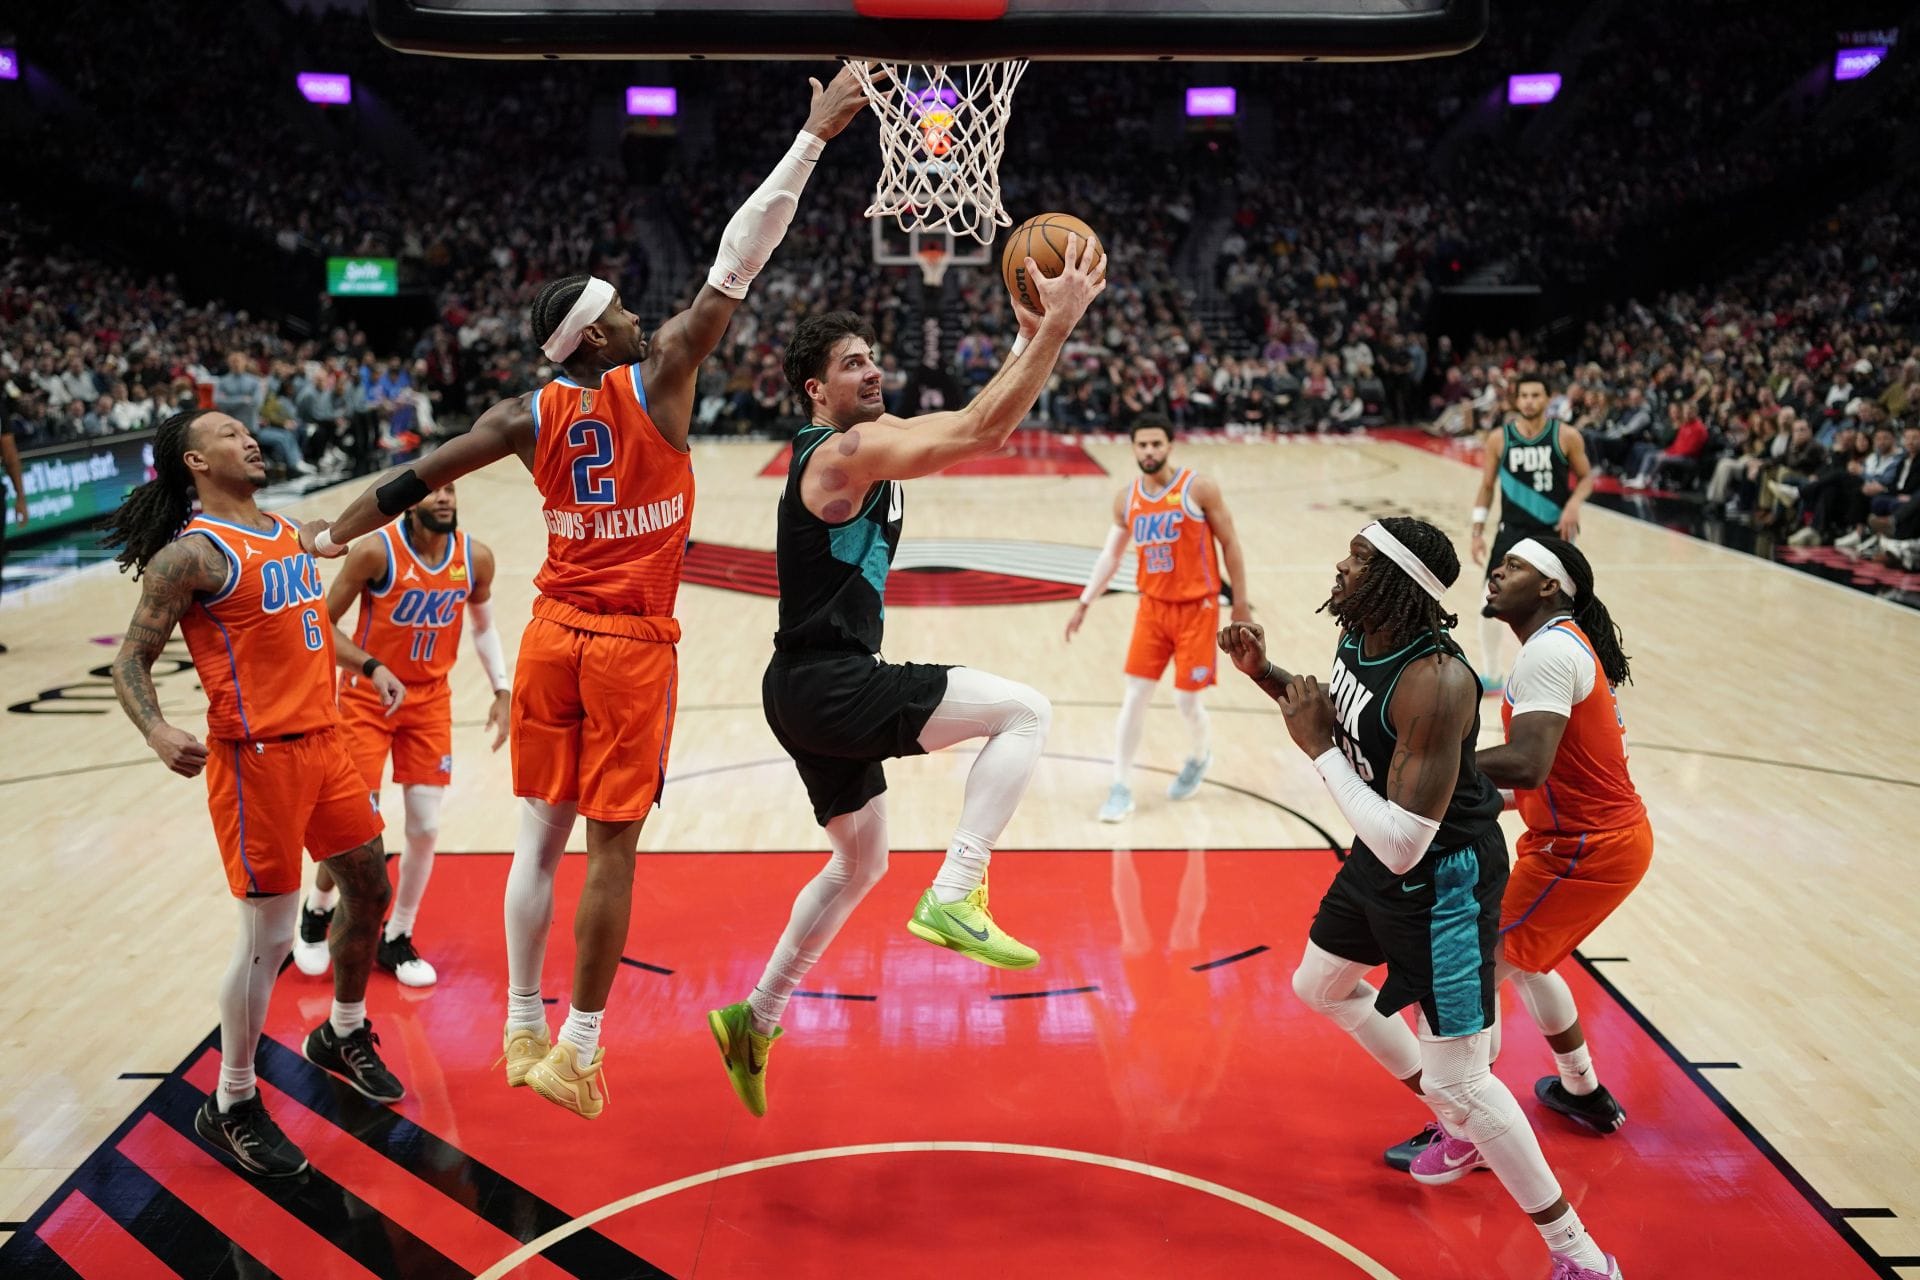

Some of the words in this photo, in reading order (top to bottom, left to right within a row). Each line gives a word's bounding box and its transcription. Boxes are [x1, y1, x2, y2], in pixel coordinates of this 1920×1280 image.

[567, 419, 616, 505] 2
[1508, 445, 1553, 473] PDX
[1133, 509, 1184, 546] OKC
[261, 552, 324, 614] OKC
[390, 588, 467, 627] OKC
[302, 608, 324, 651] 6
[410, 629, 438, 661] 11
[1328, 656, 1374, 742] PDX
